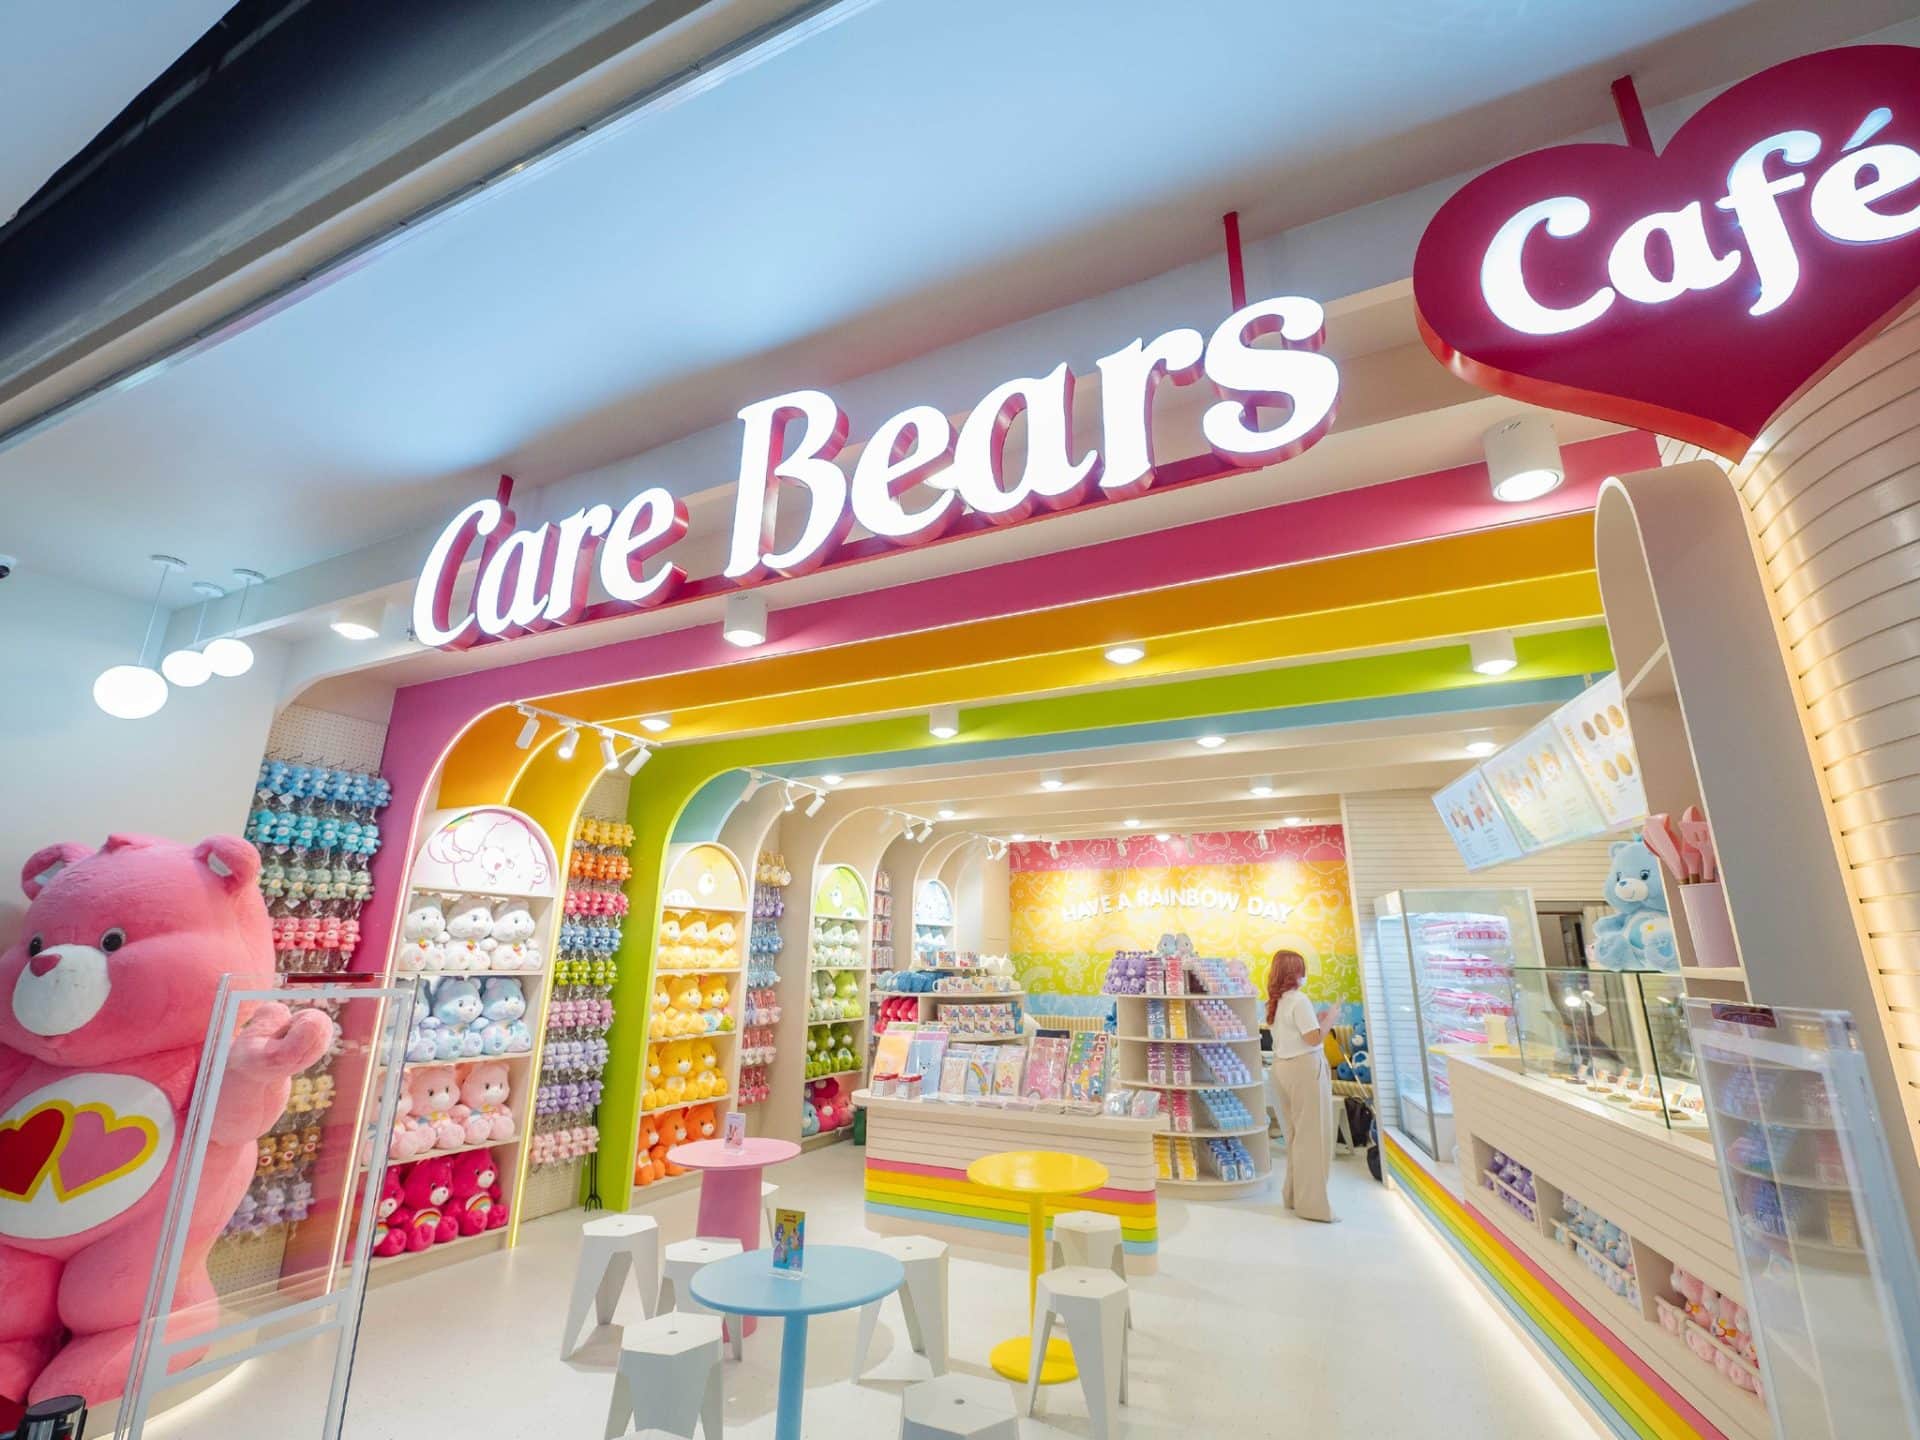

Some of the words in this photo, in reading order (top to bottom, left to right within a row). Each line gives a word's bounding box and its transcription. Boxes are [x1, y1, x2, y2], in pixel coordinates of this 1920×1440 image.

[1480, 106, 1920, 335] Café
[413, 487, 680, 648] Care
[724, 297, 1341, 580] Bears
[1062, 895, 1113, 922] HAVE
[1118, 893, 1131, 911] A
[1134, 887, 1240, 912] RAINBOW
[1247, 896, 1294, 923] DAY
